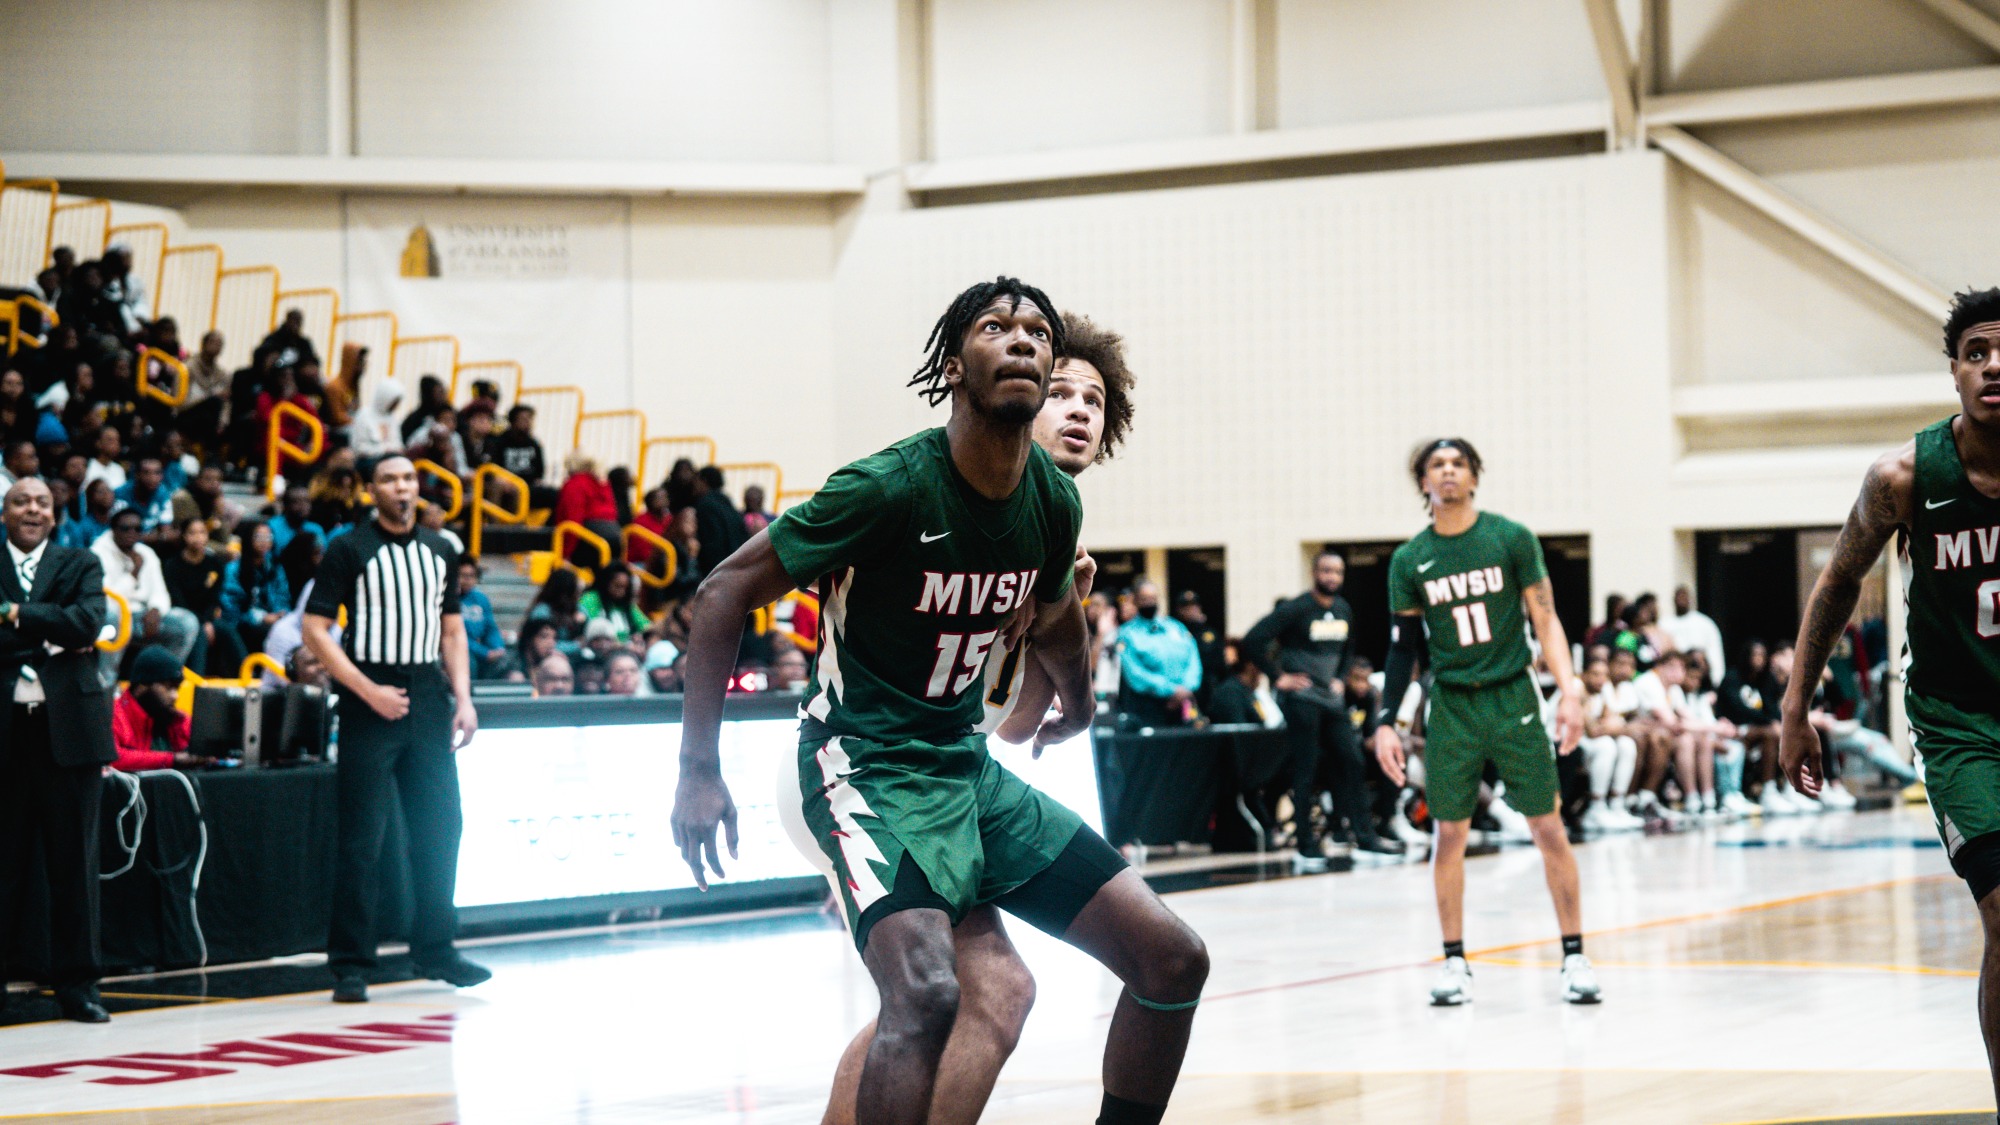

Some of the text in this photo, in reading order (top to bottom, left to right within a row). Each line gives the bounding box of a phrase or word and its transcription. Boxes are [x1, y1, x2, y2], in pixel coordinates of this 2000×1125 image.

[913, 568, 1038, 616] MVSU
[1423, 566, 1504, 607] MVSU
[1451, 602, 1493, 648] 11
[925, 628, 999, 698] 15
[0, 1012, 457, 1086] WAC
